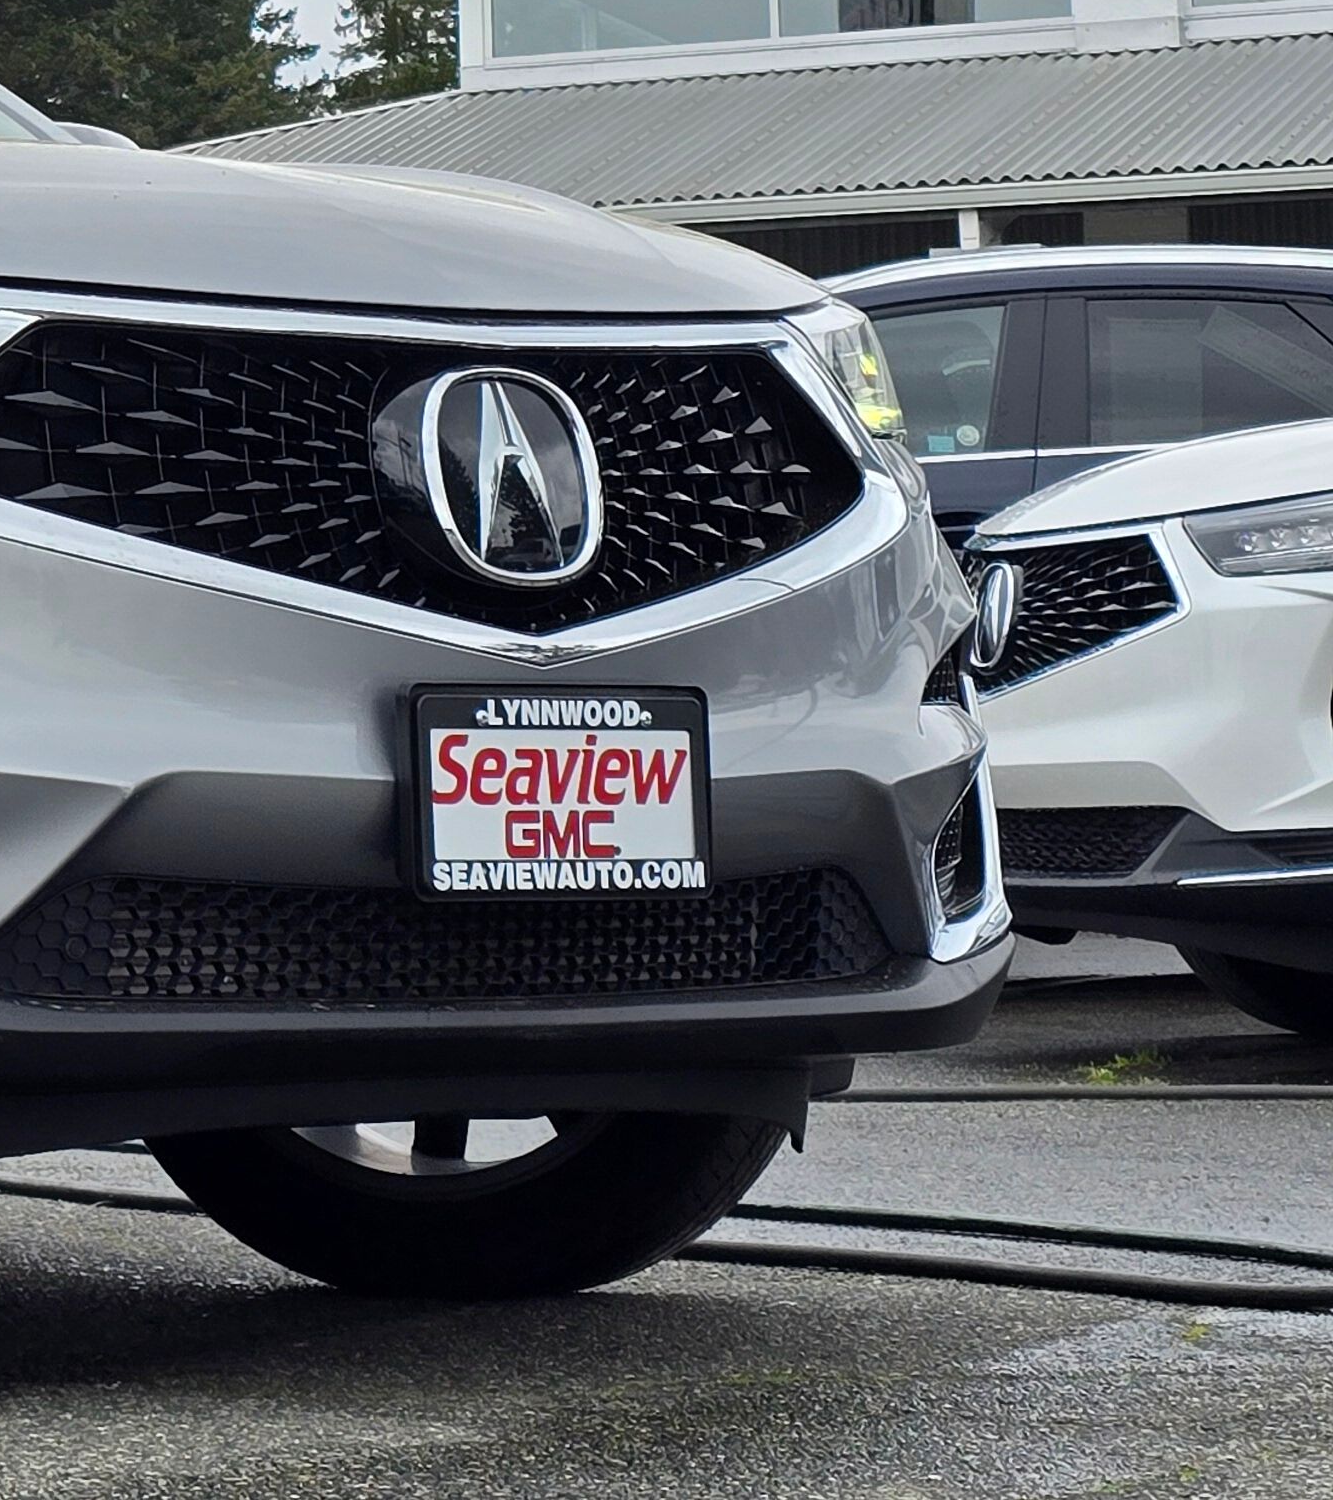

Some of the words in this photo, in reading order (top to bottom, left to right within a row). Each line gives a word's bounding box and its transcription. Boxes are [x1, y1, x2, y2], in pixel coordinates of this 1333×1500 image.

[486, 699, 641, 727] LYNNWOOD
[430, 733, 688, 806] Seaview
[505, 809, 617, 859] GMC
[433, 860, 706, 891] SEAVIEWAUTO.COM
